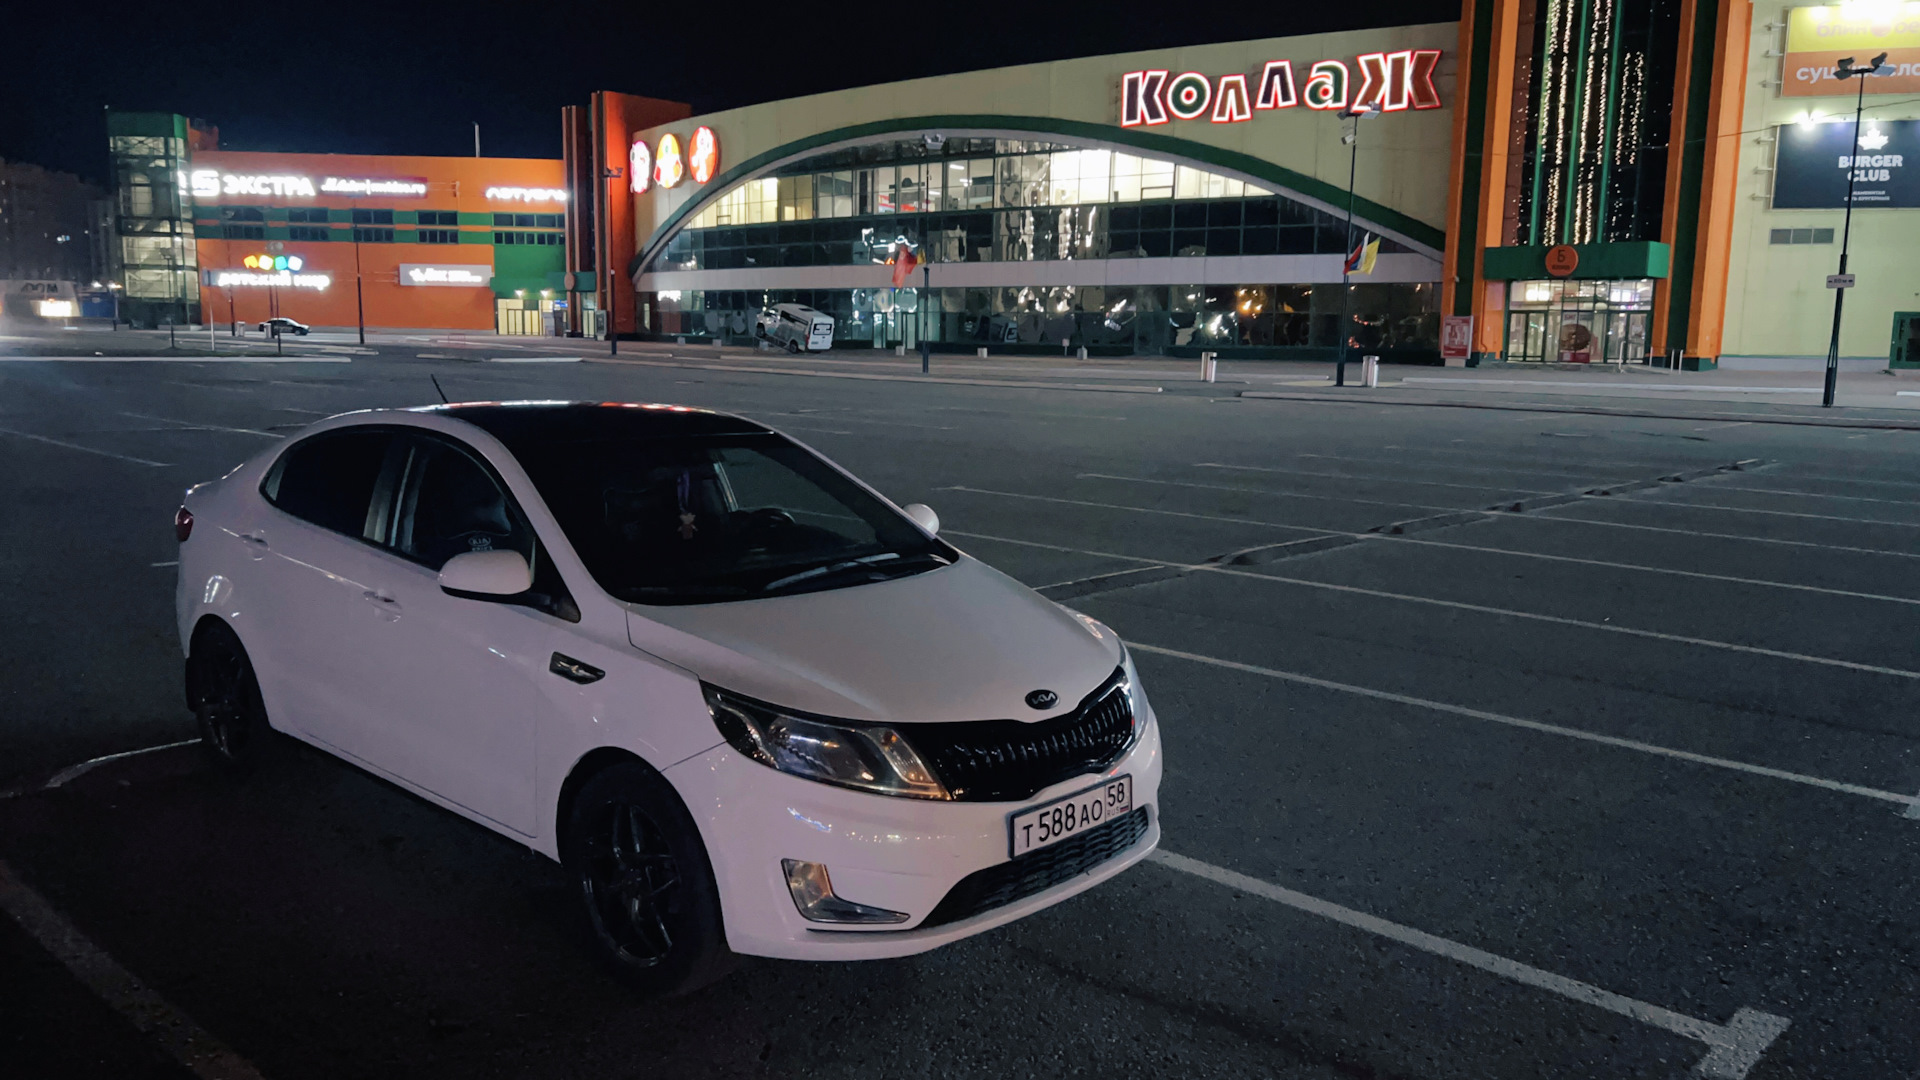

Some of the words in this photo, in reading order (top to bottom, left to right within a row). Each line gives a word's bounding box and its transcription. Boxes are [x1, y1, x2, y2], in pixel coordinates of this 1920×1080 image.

[1838, 154, 1903, 168] BURGER
[1847, 169, 1891, 182] CLUB
[222, 174, 316, 196] ЭКСТРА
[1107, 782, 1125, 807] 58
[1107, 807, 1120, 818] RUS
